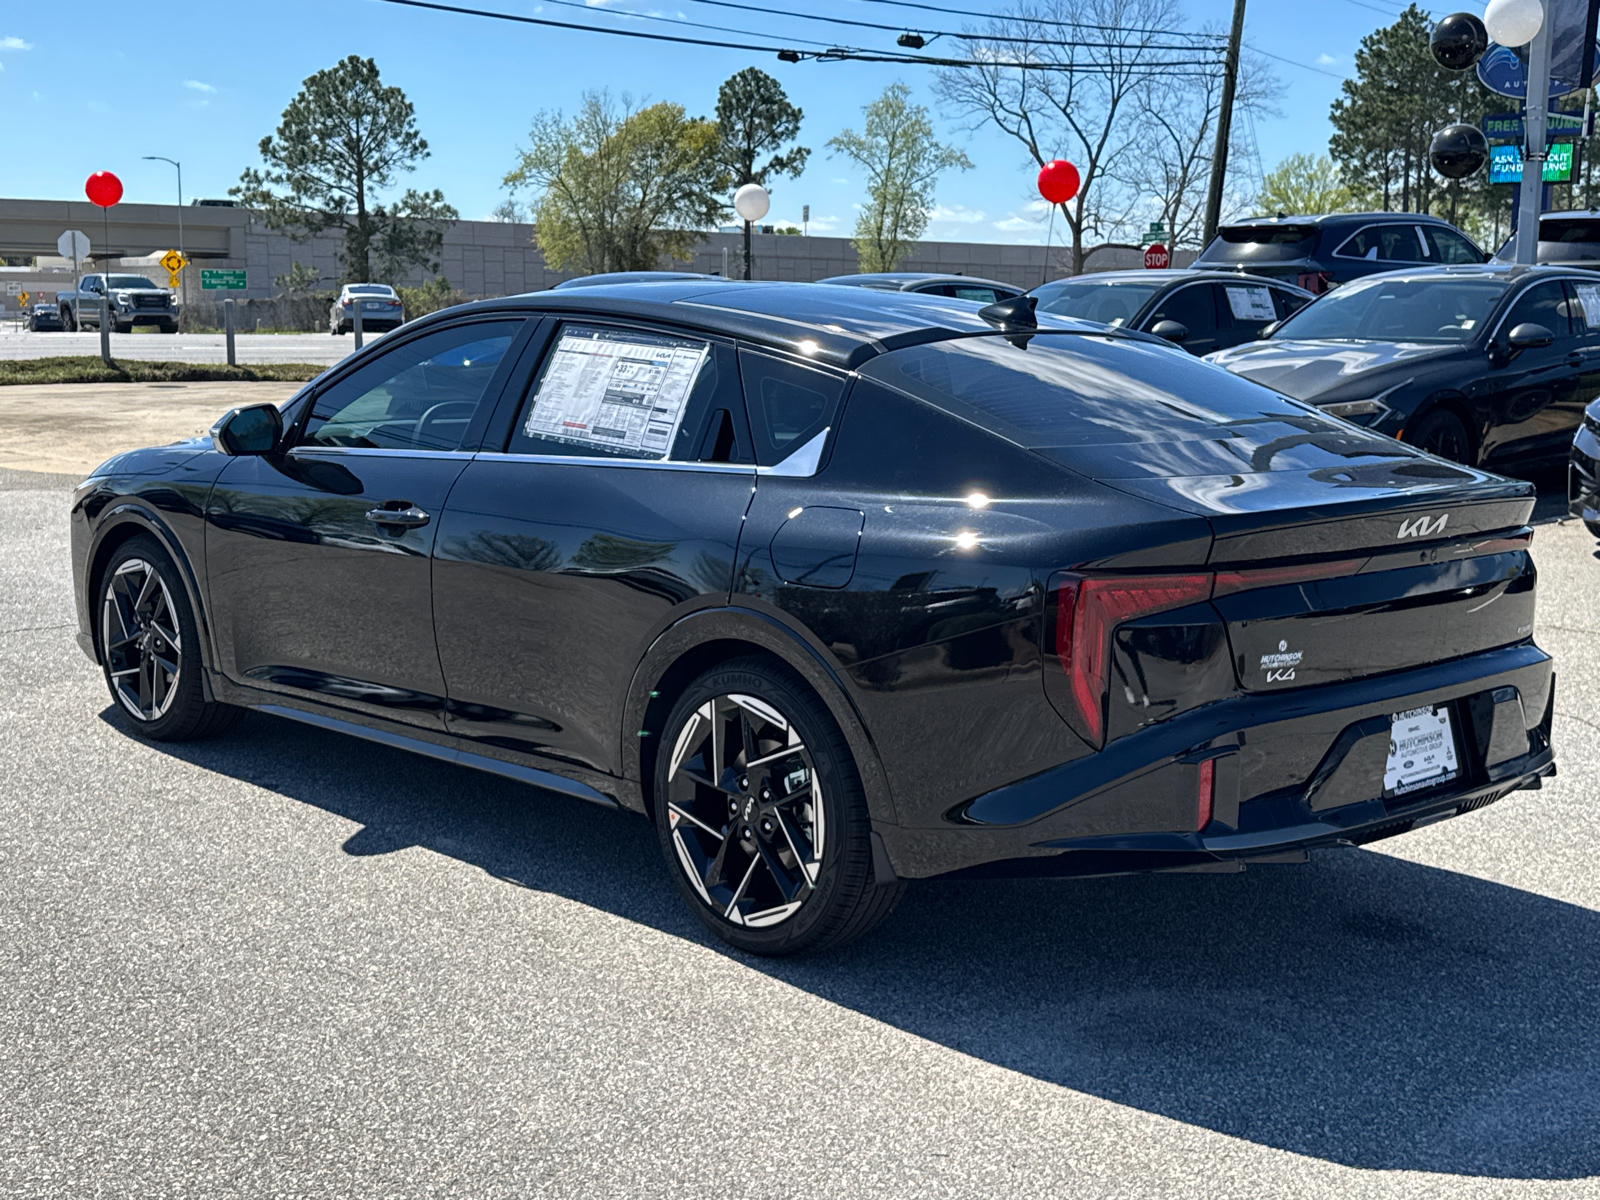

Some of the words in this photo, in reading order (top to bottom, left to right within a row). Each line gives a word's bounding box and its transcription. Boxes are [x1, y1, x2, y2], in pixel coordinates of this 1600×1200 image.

[1487, 119, 1518, 132] FREE
[1145, 253, 1168, 266] STOP
[1397, 513, 1449, 539] KIA
[1260, 650, 1304, 664] HUTCHINSON
[711, 674, 763, 688] KUMHO
[1267, 667, 1295, 682] K4
[1399, 731, 1443, 751] HUTCHINSON
[1401, 745, 1428, 758] AUTOMOTIVE
[1429, 741, 1443, 751] GROUP
